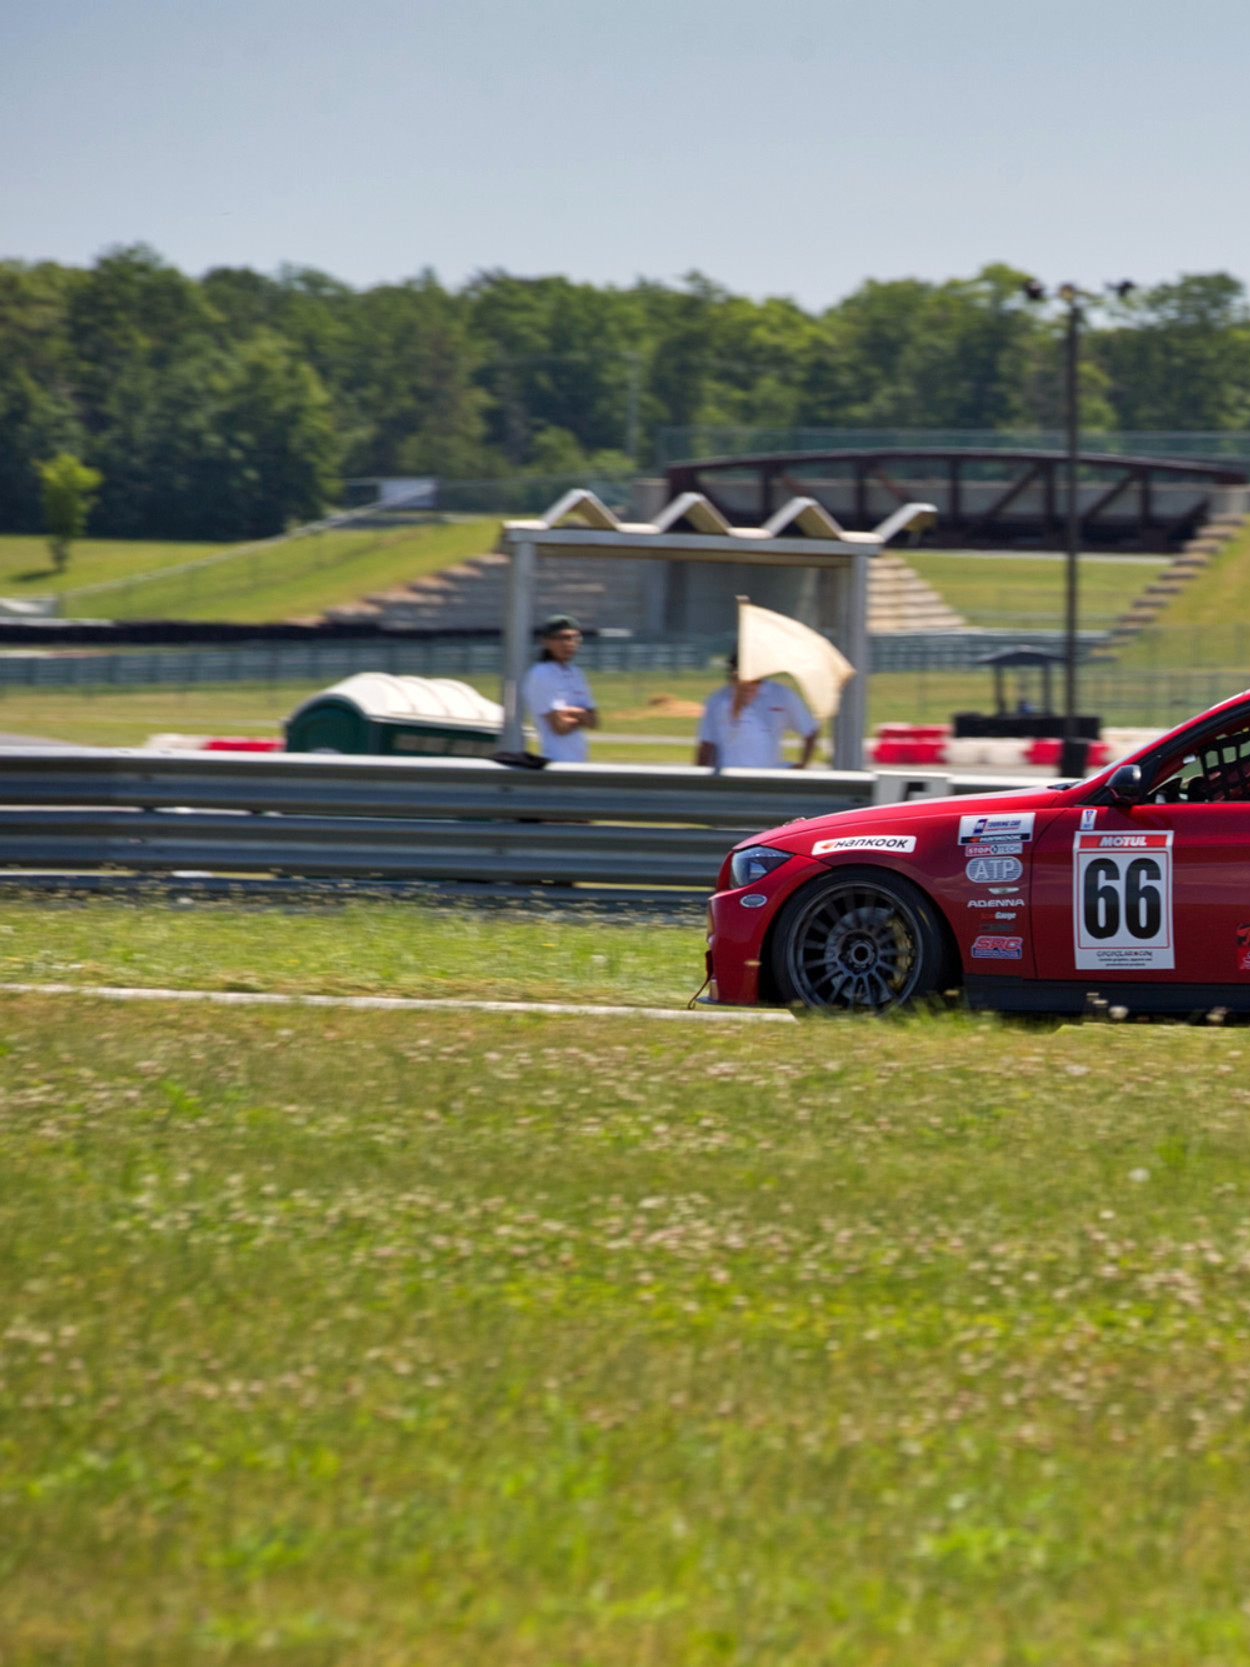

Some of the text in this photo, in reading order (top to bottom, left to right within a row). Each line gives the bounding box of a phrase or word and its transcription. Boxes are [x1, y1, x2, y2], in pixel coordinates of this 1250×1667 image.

[1100, 836, 1147, 847] MOTUL
[974, 860, 1016, 879] ATP
[967, 899, 1025, 908] ADENNA
[1084, 857, 1161, 940] 66
[975, 938, 1021, 950] SRC
